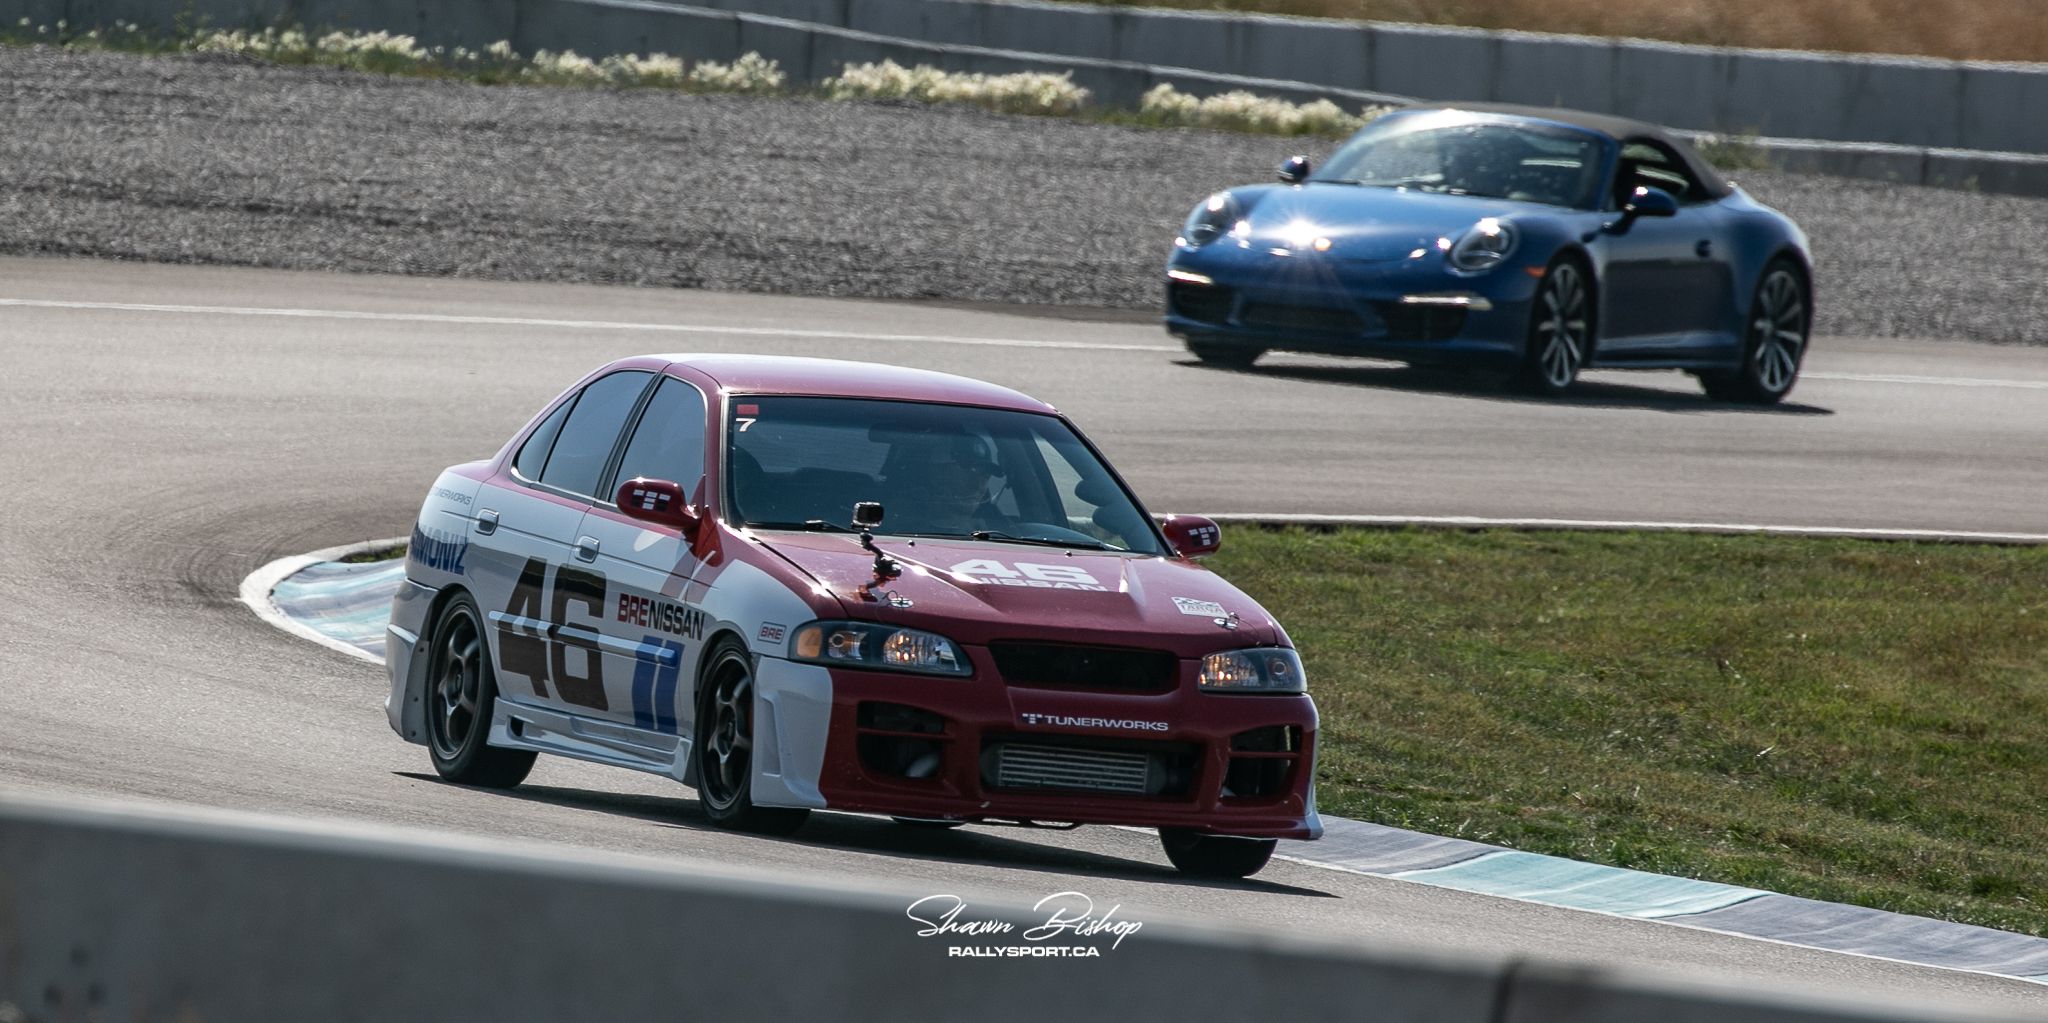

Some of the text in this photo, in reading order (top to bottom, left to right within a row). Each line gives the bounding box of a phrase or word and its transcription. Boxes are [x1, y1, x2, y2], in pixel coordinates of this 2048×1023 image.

[735, 417, 757, 432] 7
[950, 559, 1100, 585] 46
[498, 555, 609, 712] 46
[760, 626, 783, 640] BRE
[1044, 715, 1169, 731] TUNERWORKS
